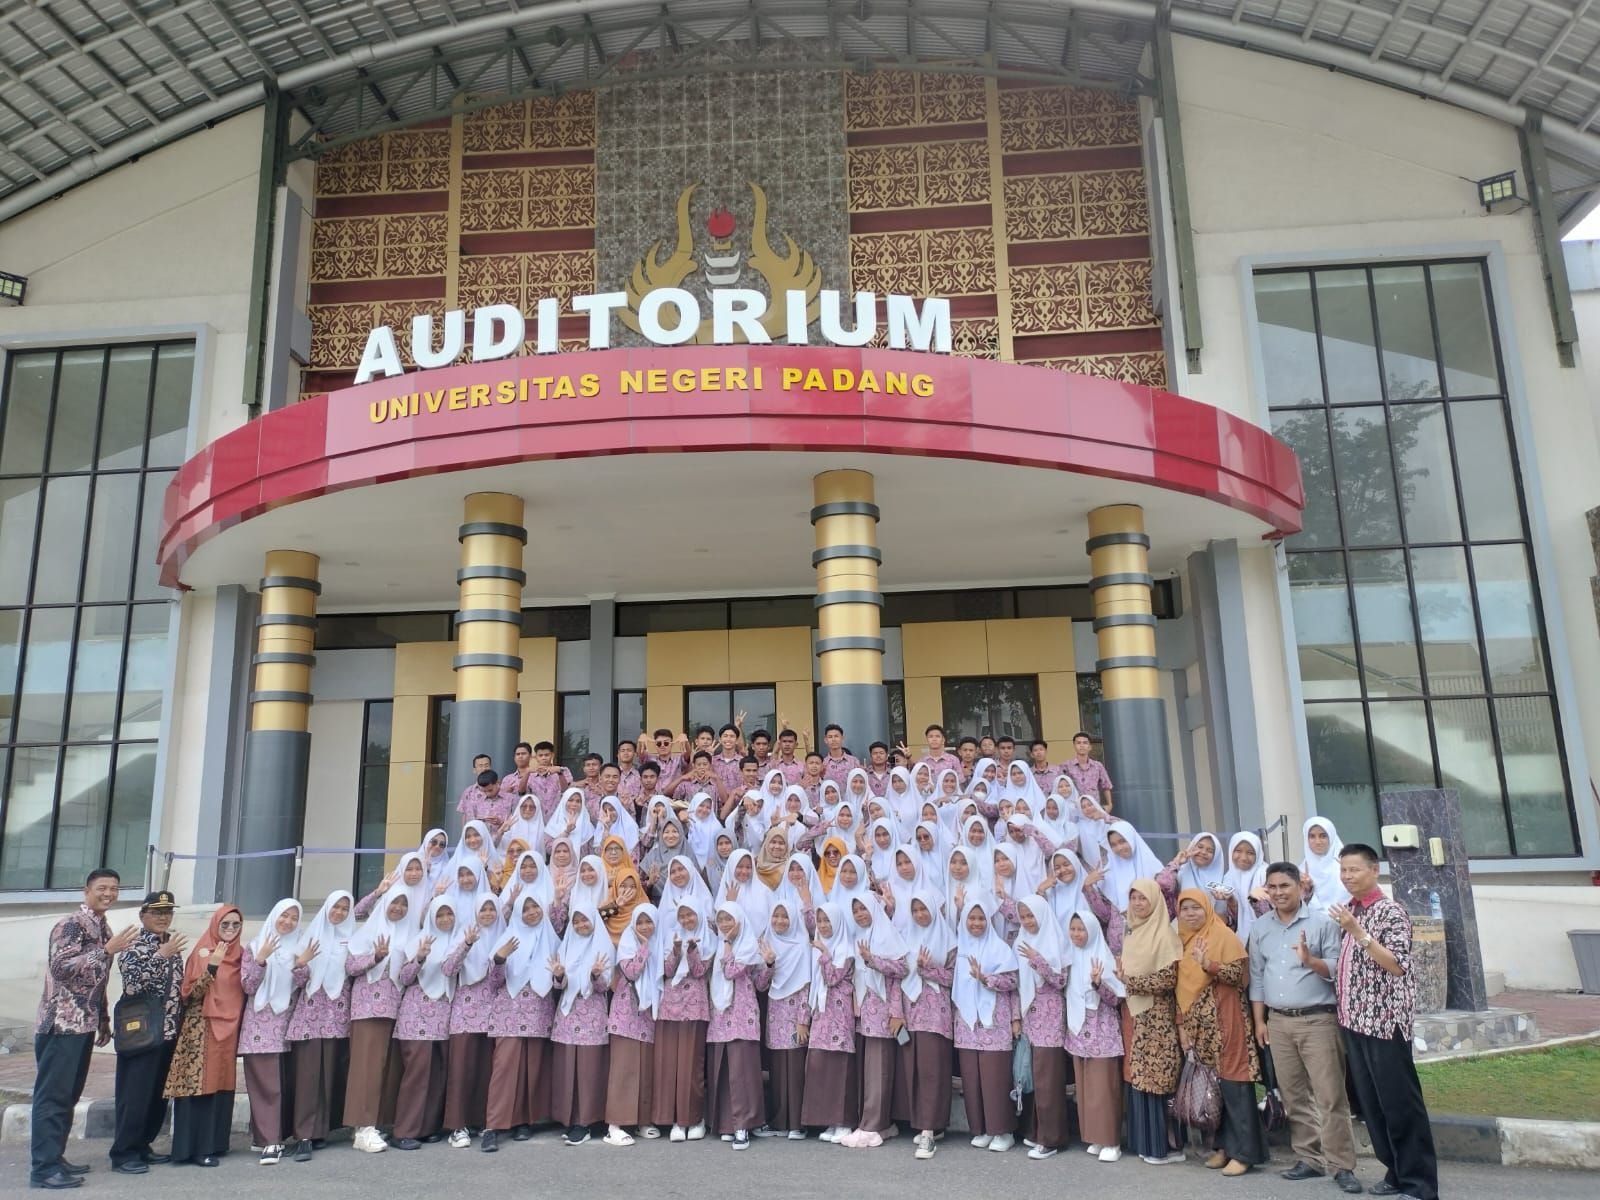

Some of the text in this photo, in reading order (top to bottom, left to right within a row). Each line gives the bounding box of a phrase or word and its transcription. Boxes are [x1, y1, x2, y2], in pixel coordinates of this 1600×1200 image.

[354, 288, 952, 384] AUDITORIUM
[369, 367, 936, 424] UNIVERSITAS NEGERI PADANG
